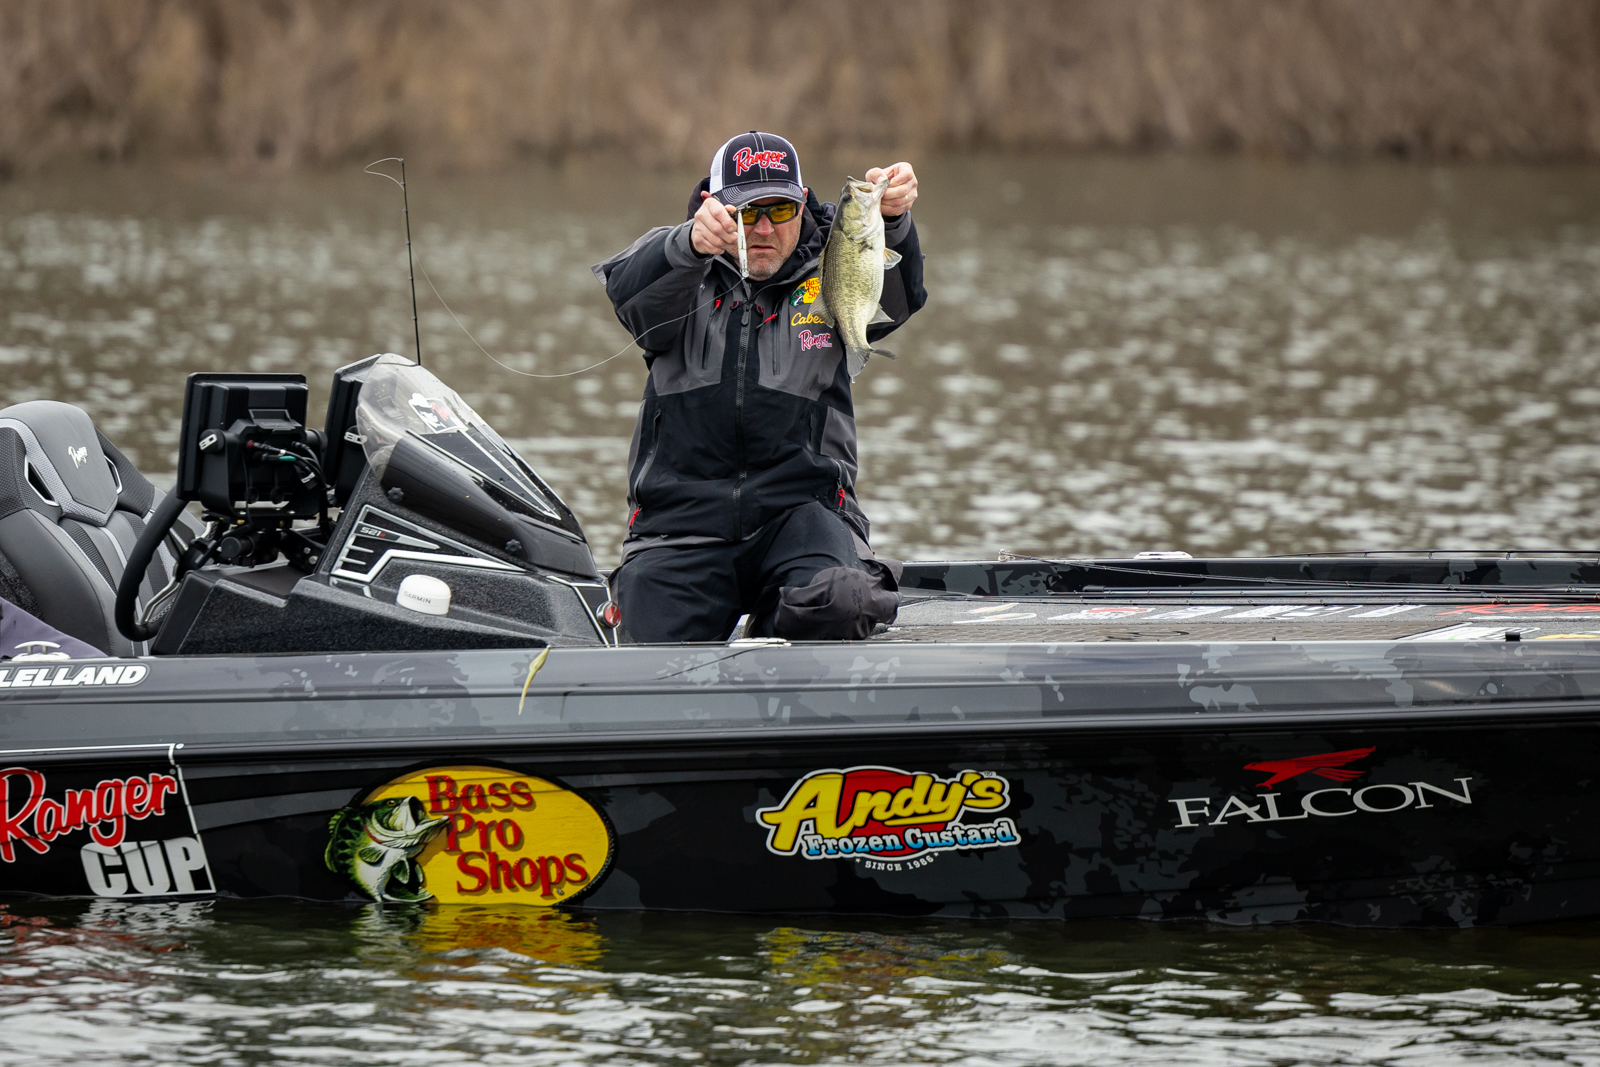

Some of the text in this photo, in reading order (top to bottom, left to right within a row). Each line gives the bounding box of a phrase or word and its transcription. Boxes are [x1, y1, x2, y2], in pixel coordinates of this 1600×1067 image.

[733, 147, 786, 176] Ranger
[806, 279, 820, 287] Bas
[791, 312, 825, 327] Cabe
[798, 329, 831, 351] Ranger
[404, 591, 431, 604] GARMIN
[425, 775, 534, 813] Bass
[761, 772, 1004, 850] Andy's
[1168, 777, 1473, 828] FALCON
[0, 767, 177, 862] Ranger
[444, 812, 521, 851] Pro
[803, 821, 1016, 855] Frozen Custard
[80, 837, 206, 896] CUP
[456, 850, 588, 897] Shops
[865, 855, 934, 871] SINCE 1986
